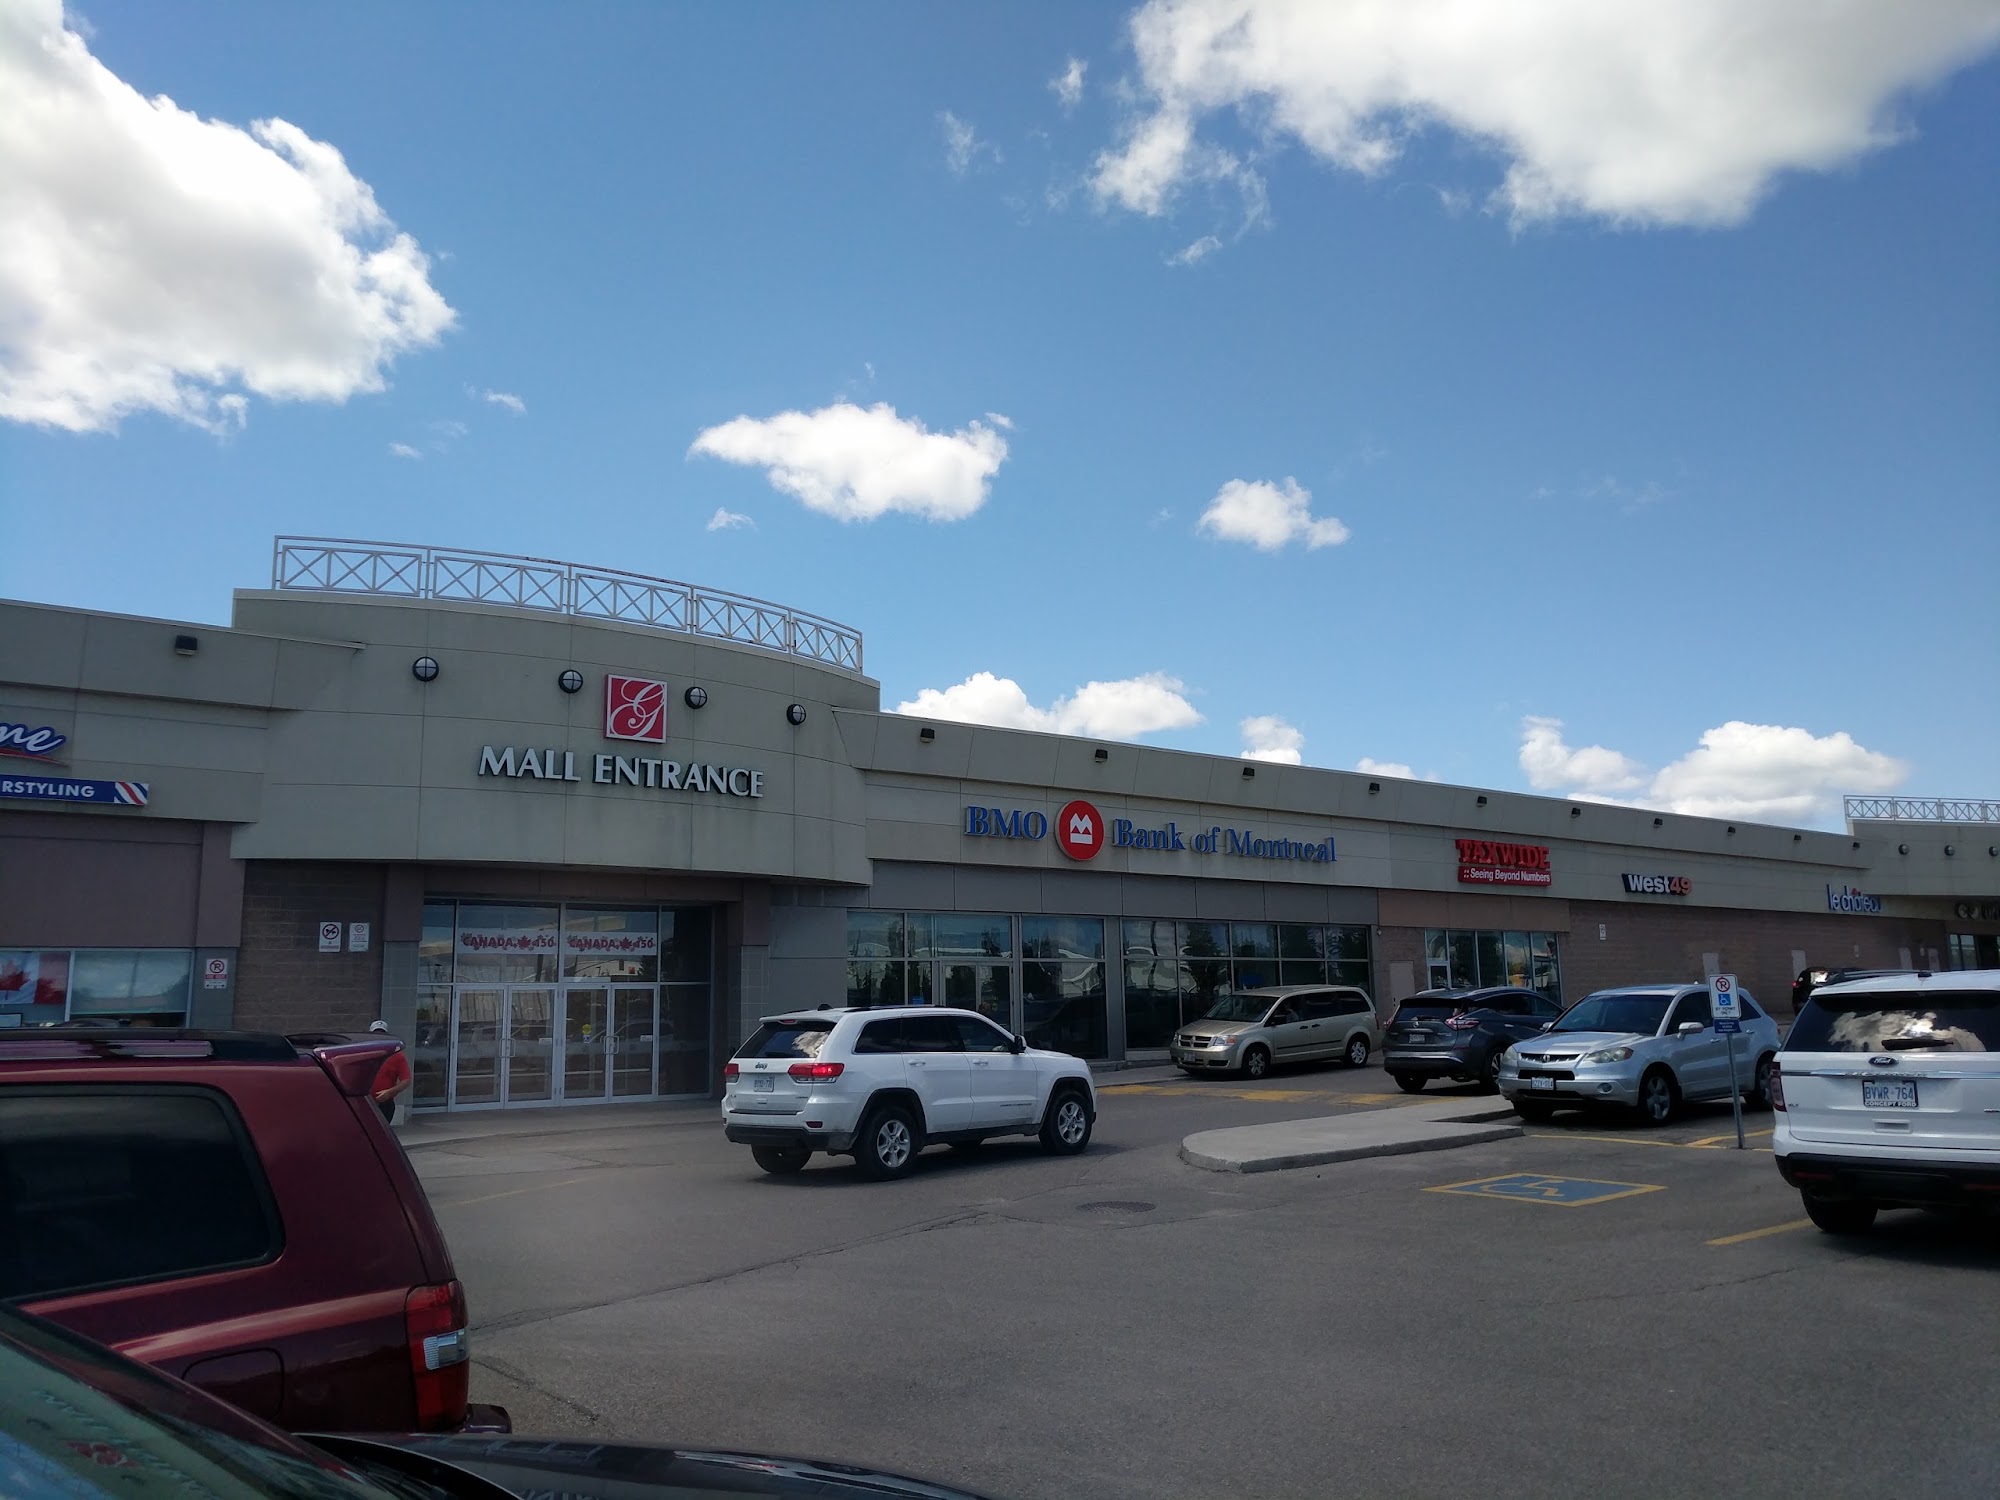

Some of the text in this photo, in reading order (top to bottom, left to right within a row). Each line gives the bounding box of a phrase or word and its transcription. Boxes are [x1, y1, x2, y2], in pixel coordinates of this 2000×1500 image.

[478, 745, 764, 798] MALL ENTRANCE
[2, 780, 95, 798] RSTYLING
[965, 805, 1048, 841] BMO
[1113, 818, 1338, 862] Bank of Montreal
[1456, 839, 1550, 869] TAXWIDE
[1470, 867, 1550, 883] Seeing Beyond Numbers
[1895, 1087, 1914, 1101] 764
